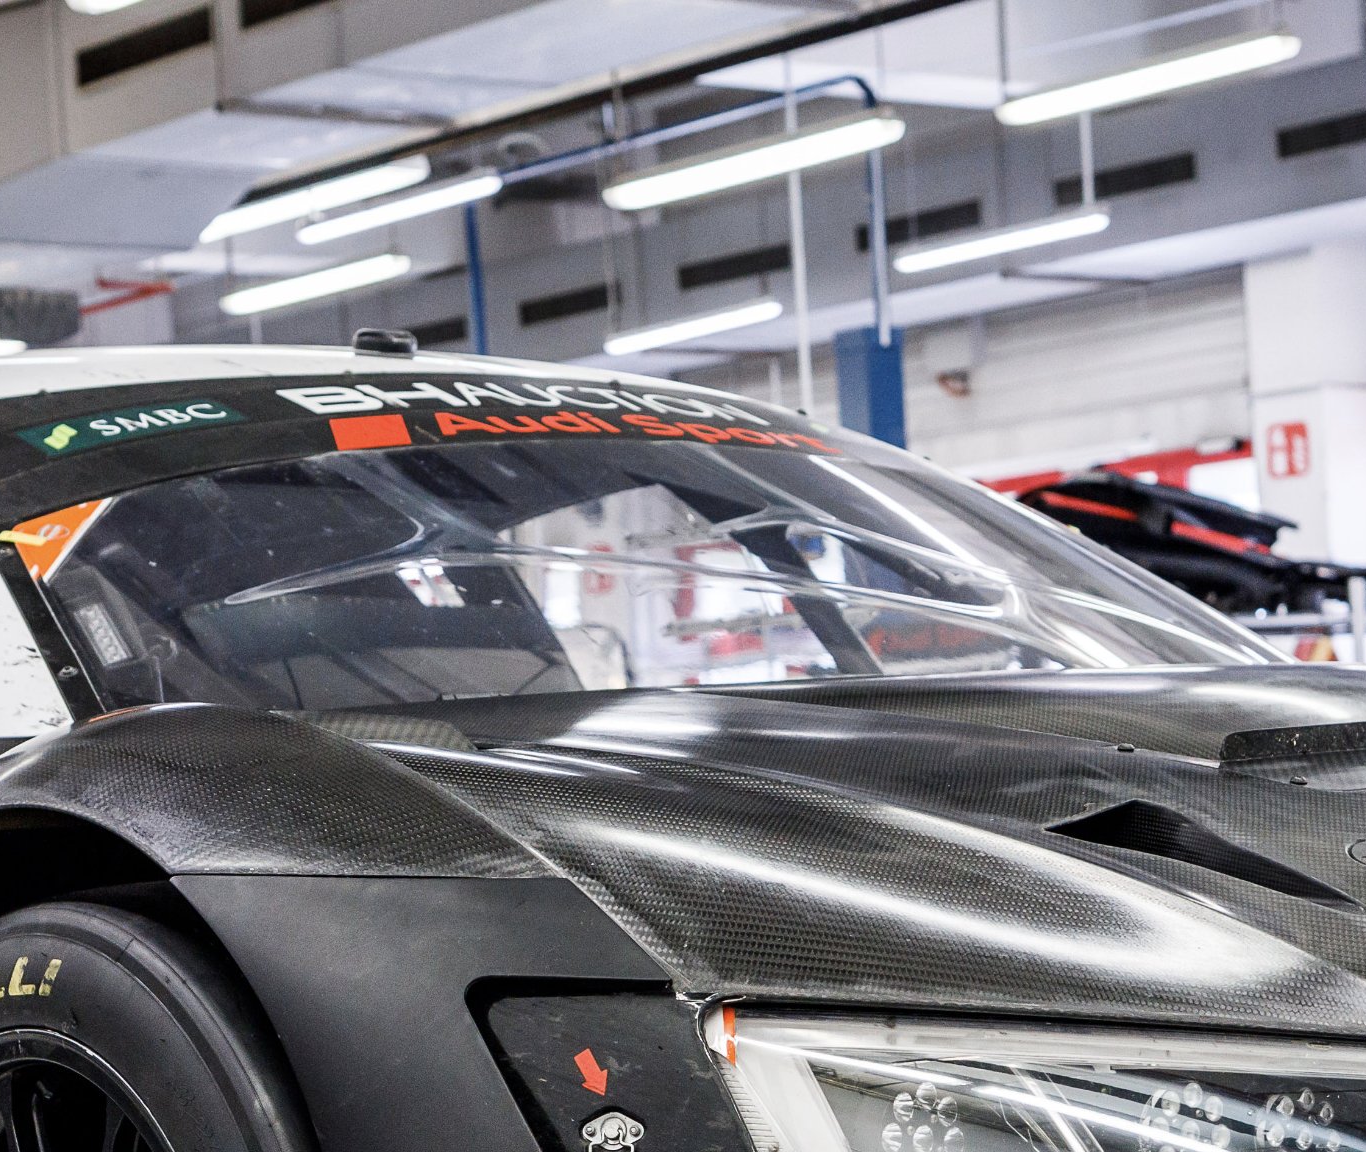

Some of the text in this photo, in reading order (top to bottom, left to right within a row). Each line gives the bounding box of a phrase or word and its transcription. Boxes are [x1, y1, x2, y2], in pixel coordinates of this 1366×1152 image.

[90, 403, 227, 437] SMBC
[276, 383, 770, 427] BHAUCTION
[435, 410, 842, 455] Audi Sport
